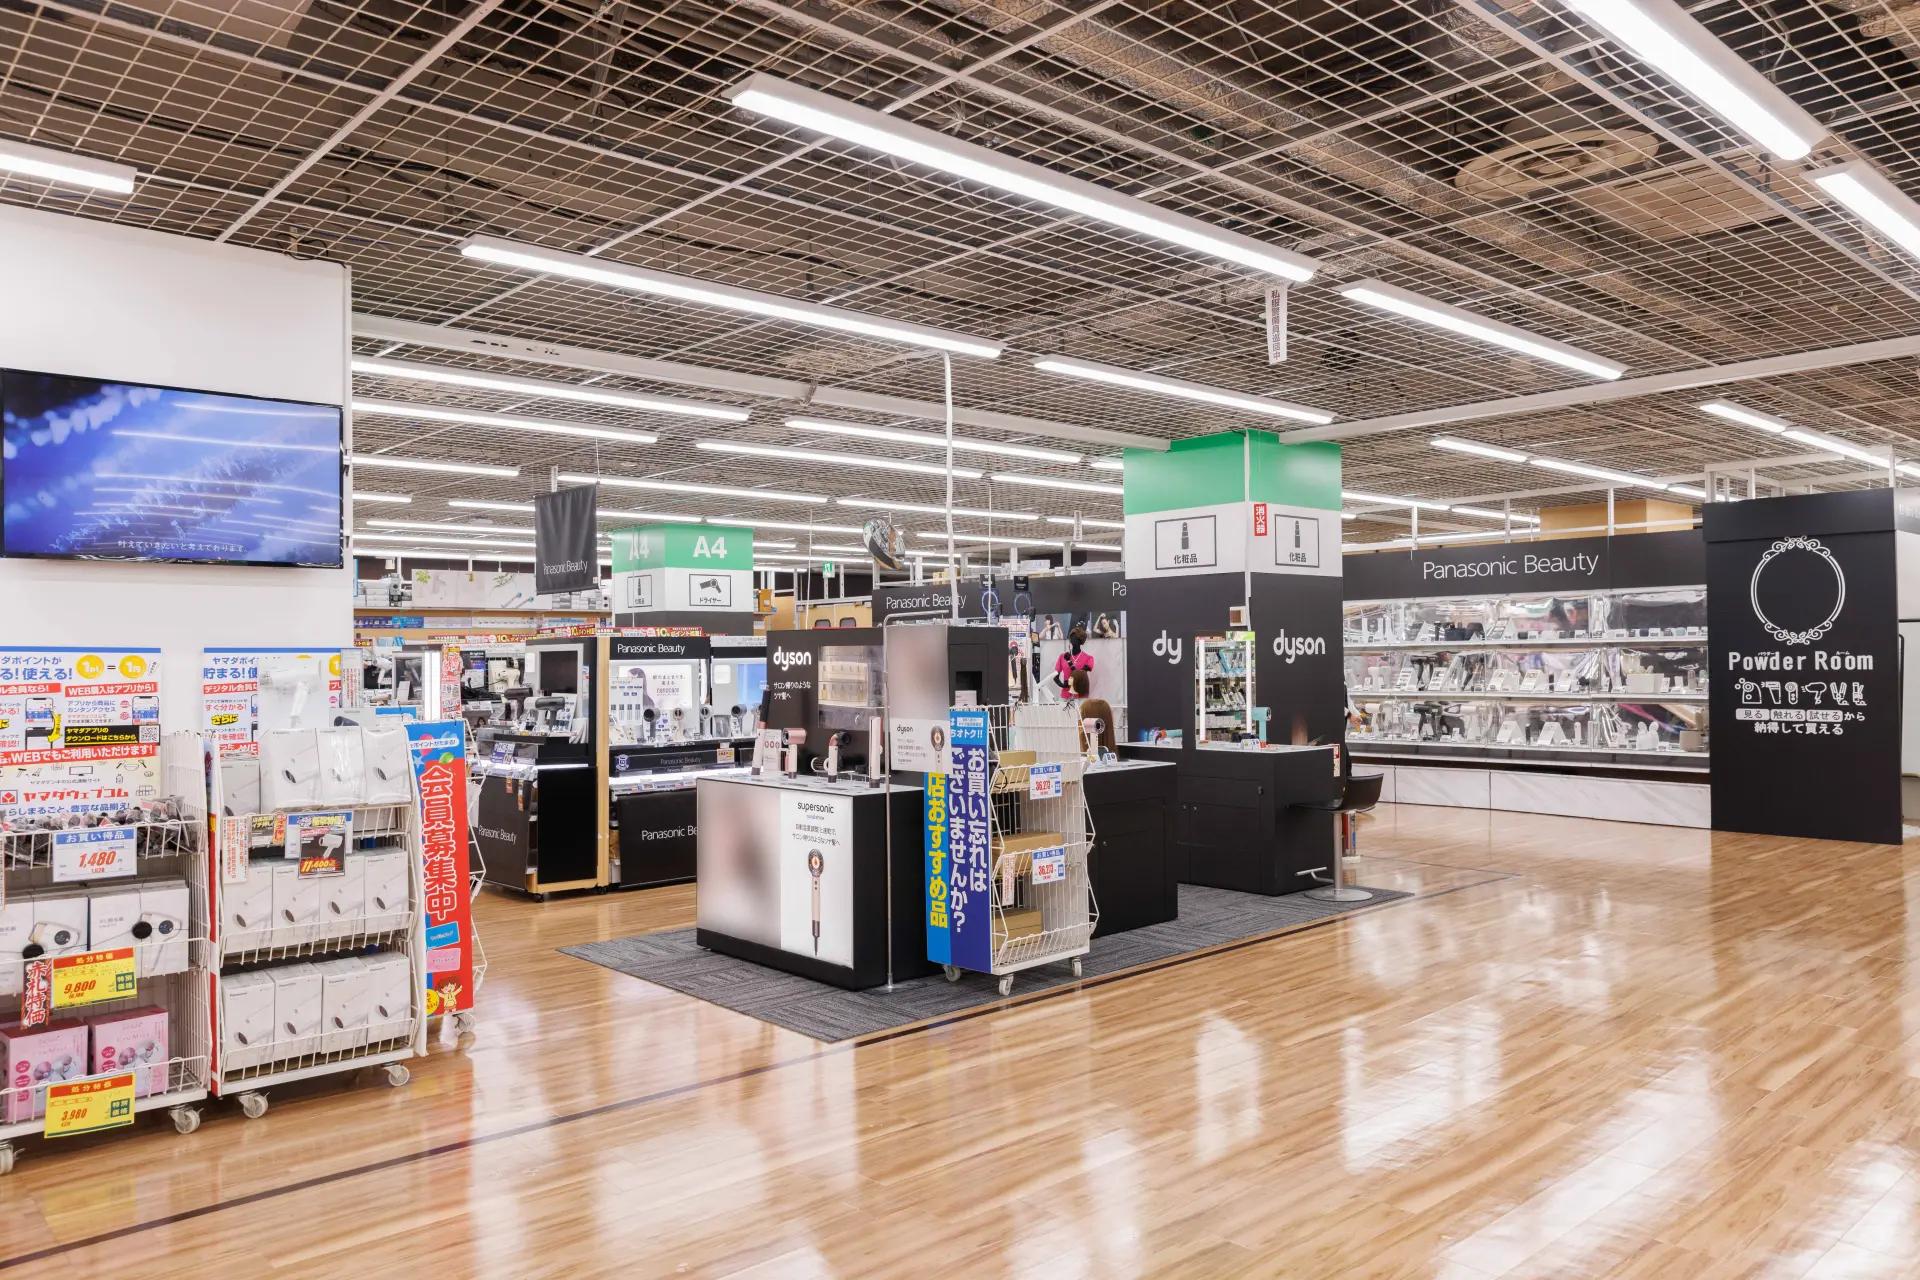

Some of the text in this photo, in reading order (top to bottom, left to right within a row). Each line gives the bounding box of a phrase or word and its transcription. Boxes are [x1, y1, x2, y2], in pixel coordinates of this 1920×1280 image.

[1255, 506, 1266, 534] 消火器
[629, 536, 649, 561] A4
[693, 535, 728, 559] A4
[1174, 553, 1198, 564] 化粧品
[1289, 552, 1307, 563] 化粧品
[544, 560, 588, 575] Panasonic Beauty
[1423, 553, 1599, 580] Panasonic Beauty
[1112, 582, 1127, 596] Pa
[886, 594, 930, 610] Panasonic
[617, 643, 685, 655] Panasonic Beauty
[1273, 629, 1326, 664] dyson
[773, 646, 812, 671] dyson
[1728, 651, 1874, 671] Powder Room
[211, 714, 239, 726] さらに
[1743, 710, 1866, 722] 見る 触れる 試せる から
[896, 724, 914, 734] dyson
[1754, 722, 1844, 736] 納得して買える
[684, 757, 702, 765] Beauty
[23, 786, 129, 802] ヤマダウェブコム
[797, 802, 834, 814] supersonic
[968, 747, 987, 893] お買い忘れは
[478, 825, 517, 845] Panasonic Beauty
[642, 827, 686, 841] Panasonic
[419, 765, 457, 921] 会員募集中
[927, 772, 948, 929] 店おすすめ品
[79, 851, 117, 868] 1,480
[26, 961, 48, 1027] 赤札特価
[63, 979, 96, 995] 9,800
[61, 1108, 88, 1121] 3,980
